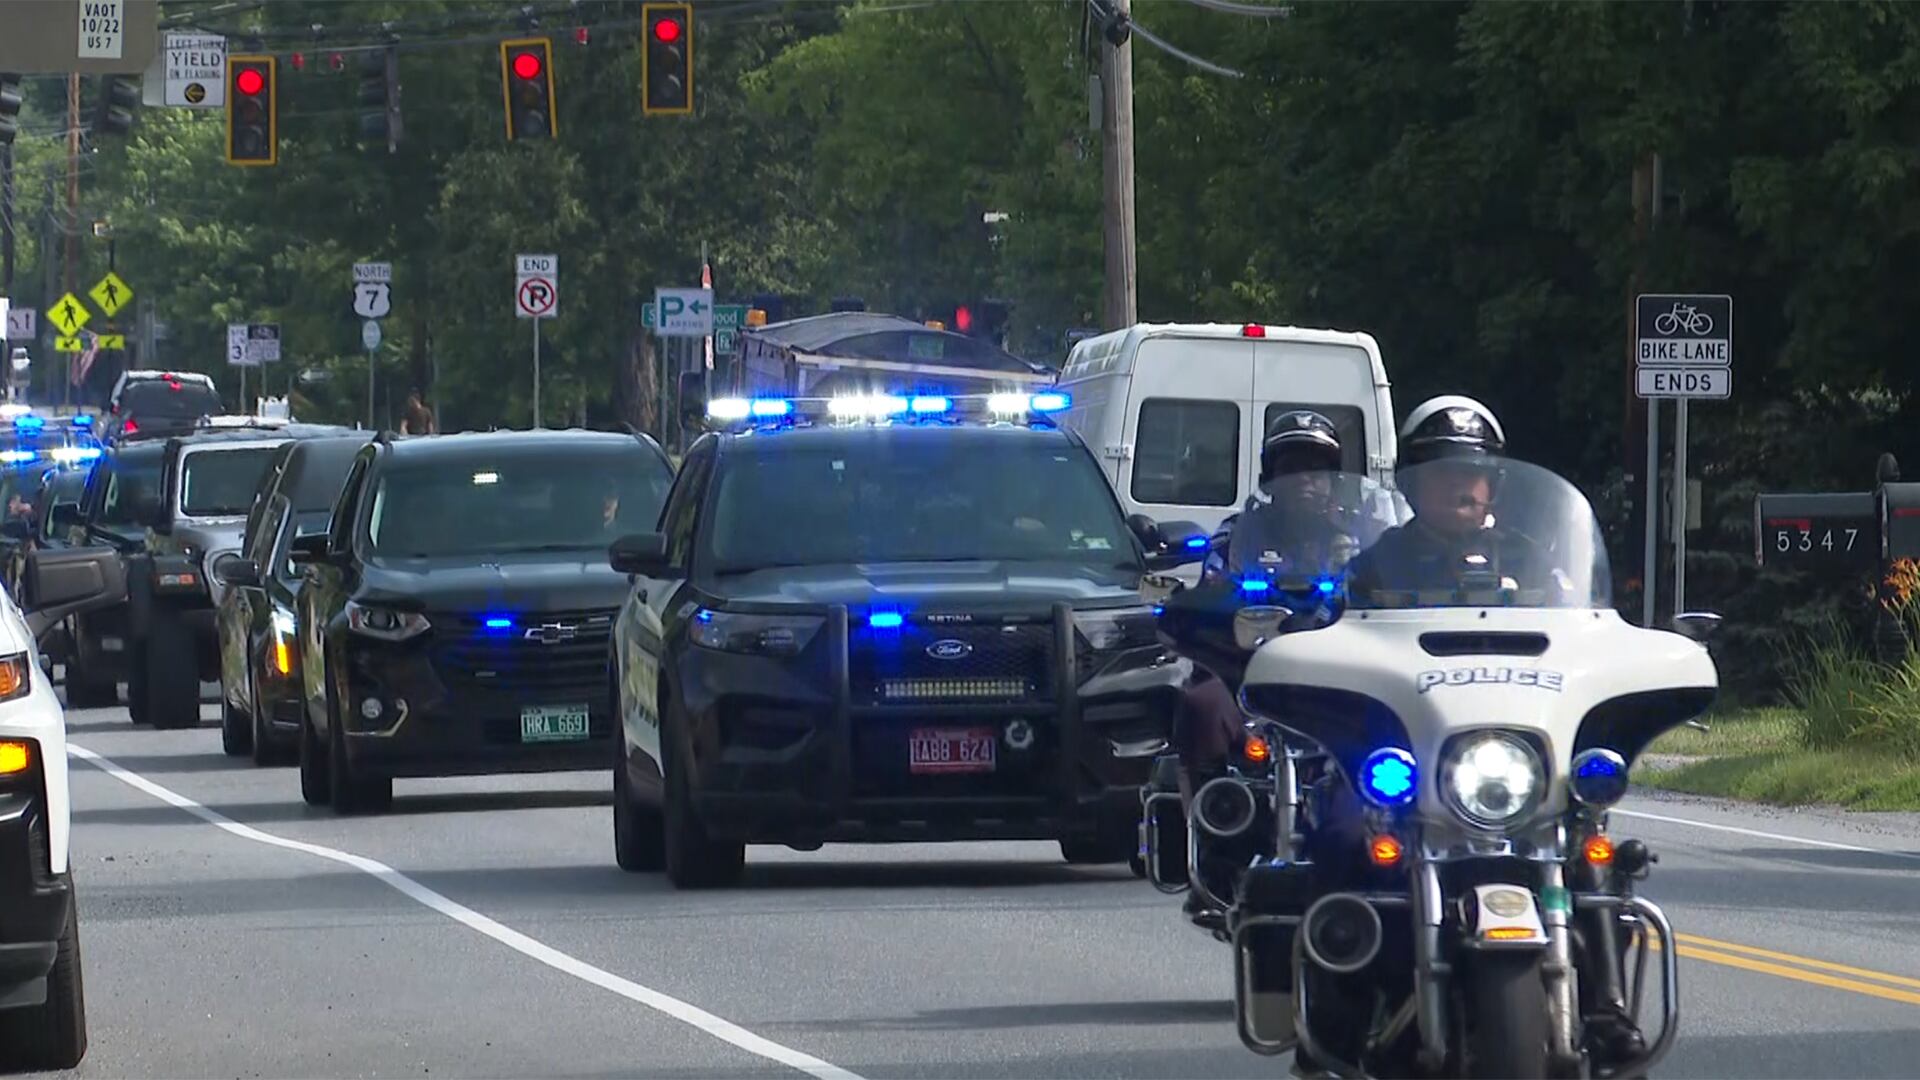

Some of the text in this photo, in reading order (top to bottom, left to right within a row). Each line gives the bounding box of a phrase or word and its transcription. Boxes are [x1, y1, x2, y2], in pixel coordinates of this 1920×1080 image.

[84, 4, 117, 16] VAOT
[82, 19, 119, 33] 10/22
[88, 37, 112, 49] US 7
[171, 52, 221, 67] YIELD
[355, 266, 390, 278] NORTH
[523, 259, 550, 271] END
[365, 290, 379, 310] 7
[1641, 342, 1726, 359] BIKE LANE
[1654, 374, 1712, 391] ENDS
[1777, 529, 1858, 552] 5347
[936, 644, 963, 656] Ford
[1417, 667, 1563, 694] POLICE
[526, 714, 583, 734] HRA 669
[960, 740, 991, 761] 624
